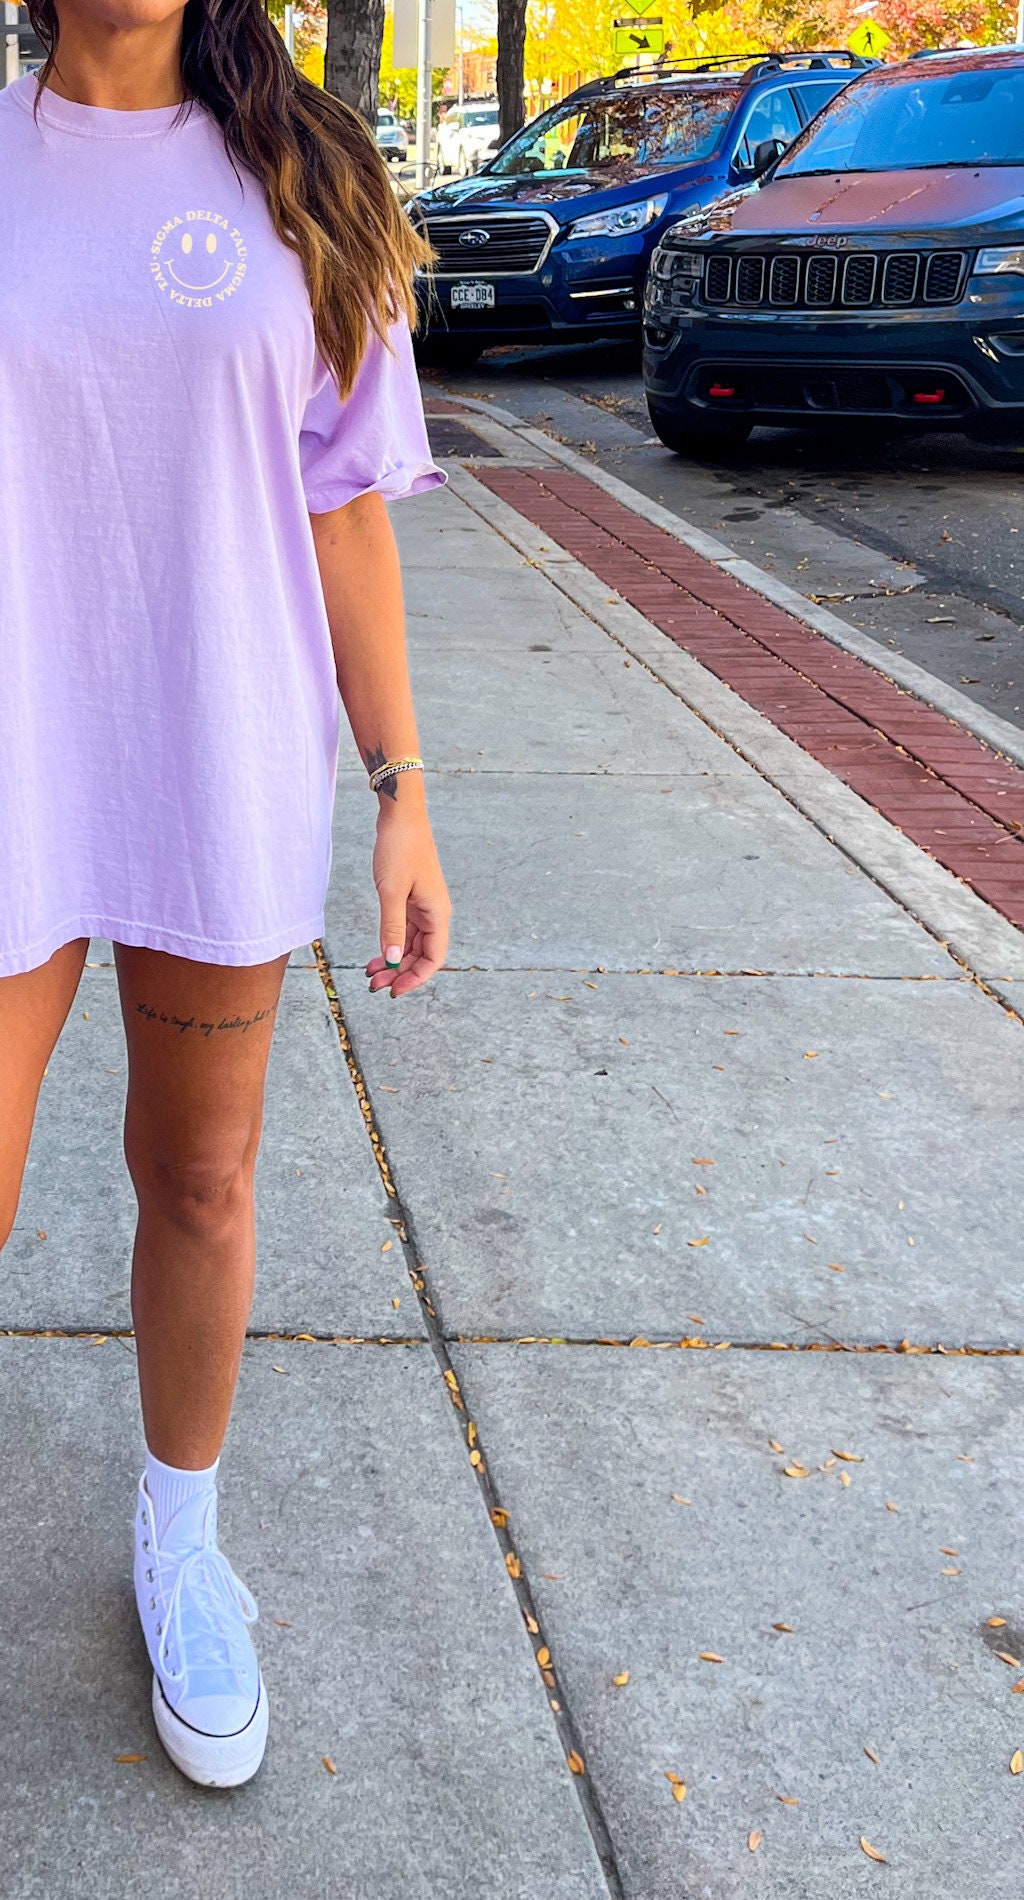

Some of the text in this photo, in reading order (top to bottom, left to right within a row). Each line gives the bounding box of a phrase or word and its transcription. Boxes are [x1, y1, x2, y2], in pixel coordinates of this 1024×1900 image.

[150, 210, 247, 307] SIGMA DELTA TAU SIGMA DELTA TAU
[806, 235, 848, 248] Jeep
